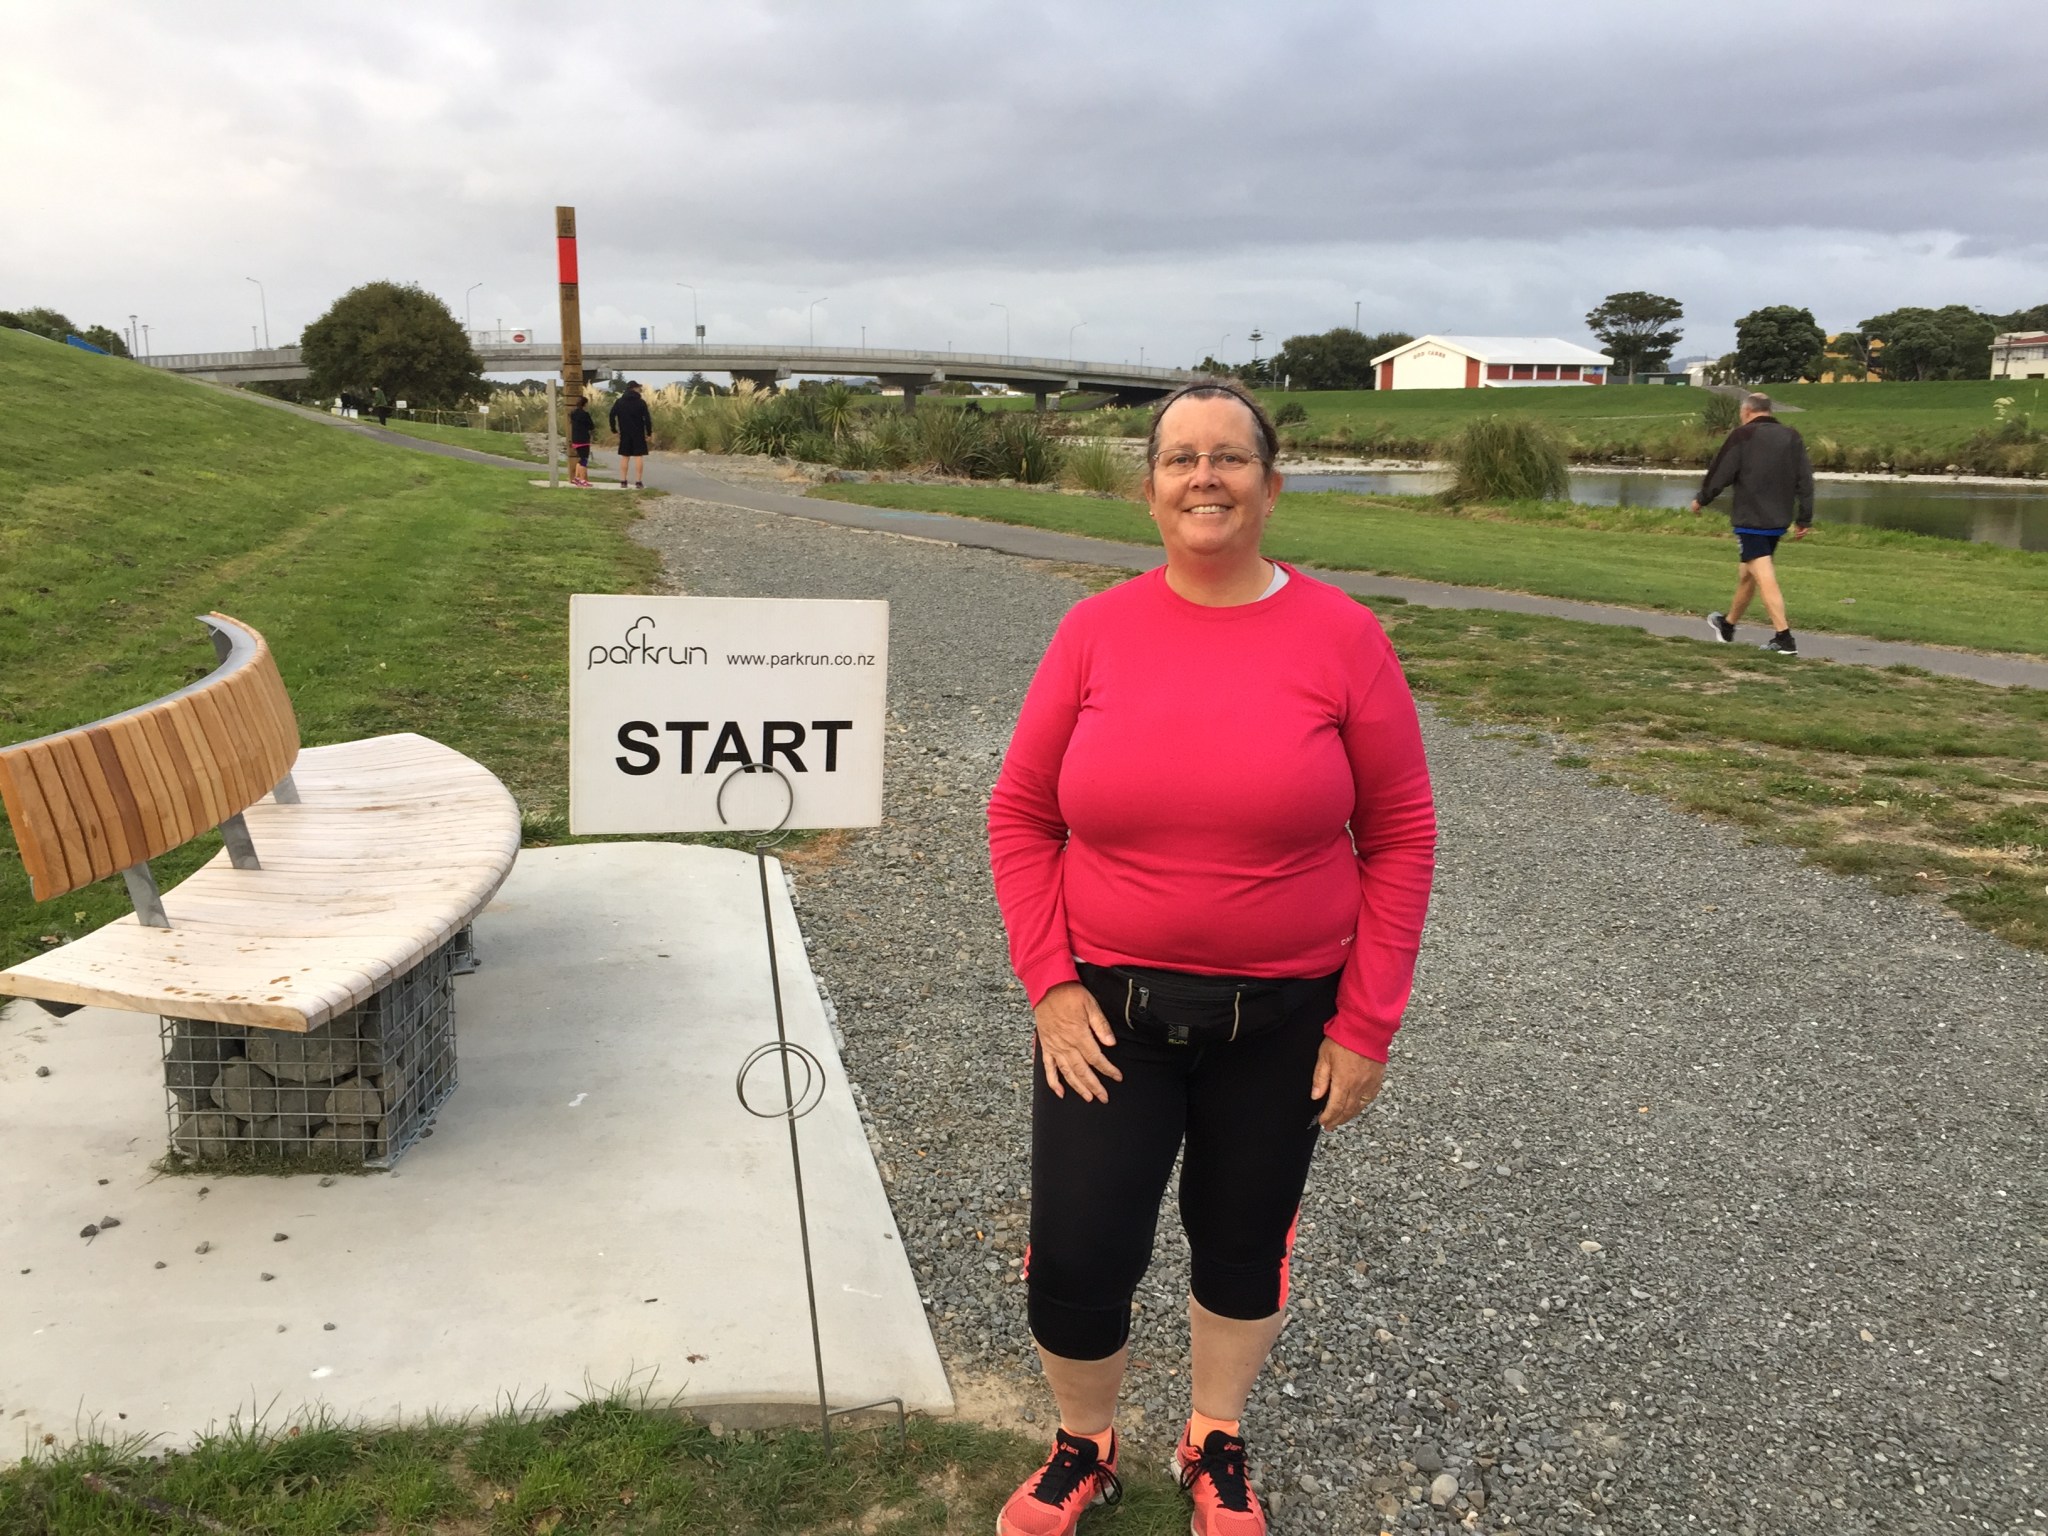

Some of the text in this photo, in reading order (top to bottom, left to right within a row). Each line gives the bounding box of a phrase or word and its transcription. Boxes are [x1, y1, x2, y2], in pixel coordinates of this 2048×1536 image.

[587, 616, 876, 670] parkrun www.parkrun.co.nz
[615, 720, 853, 776] START
